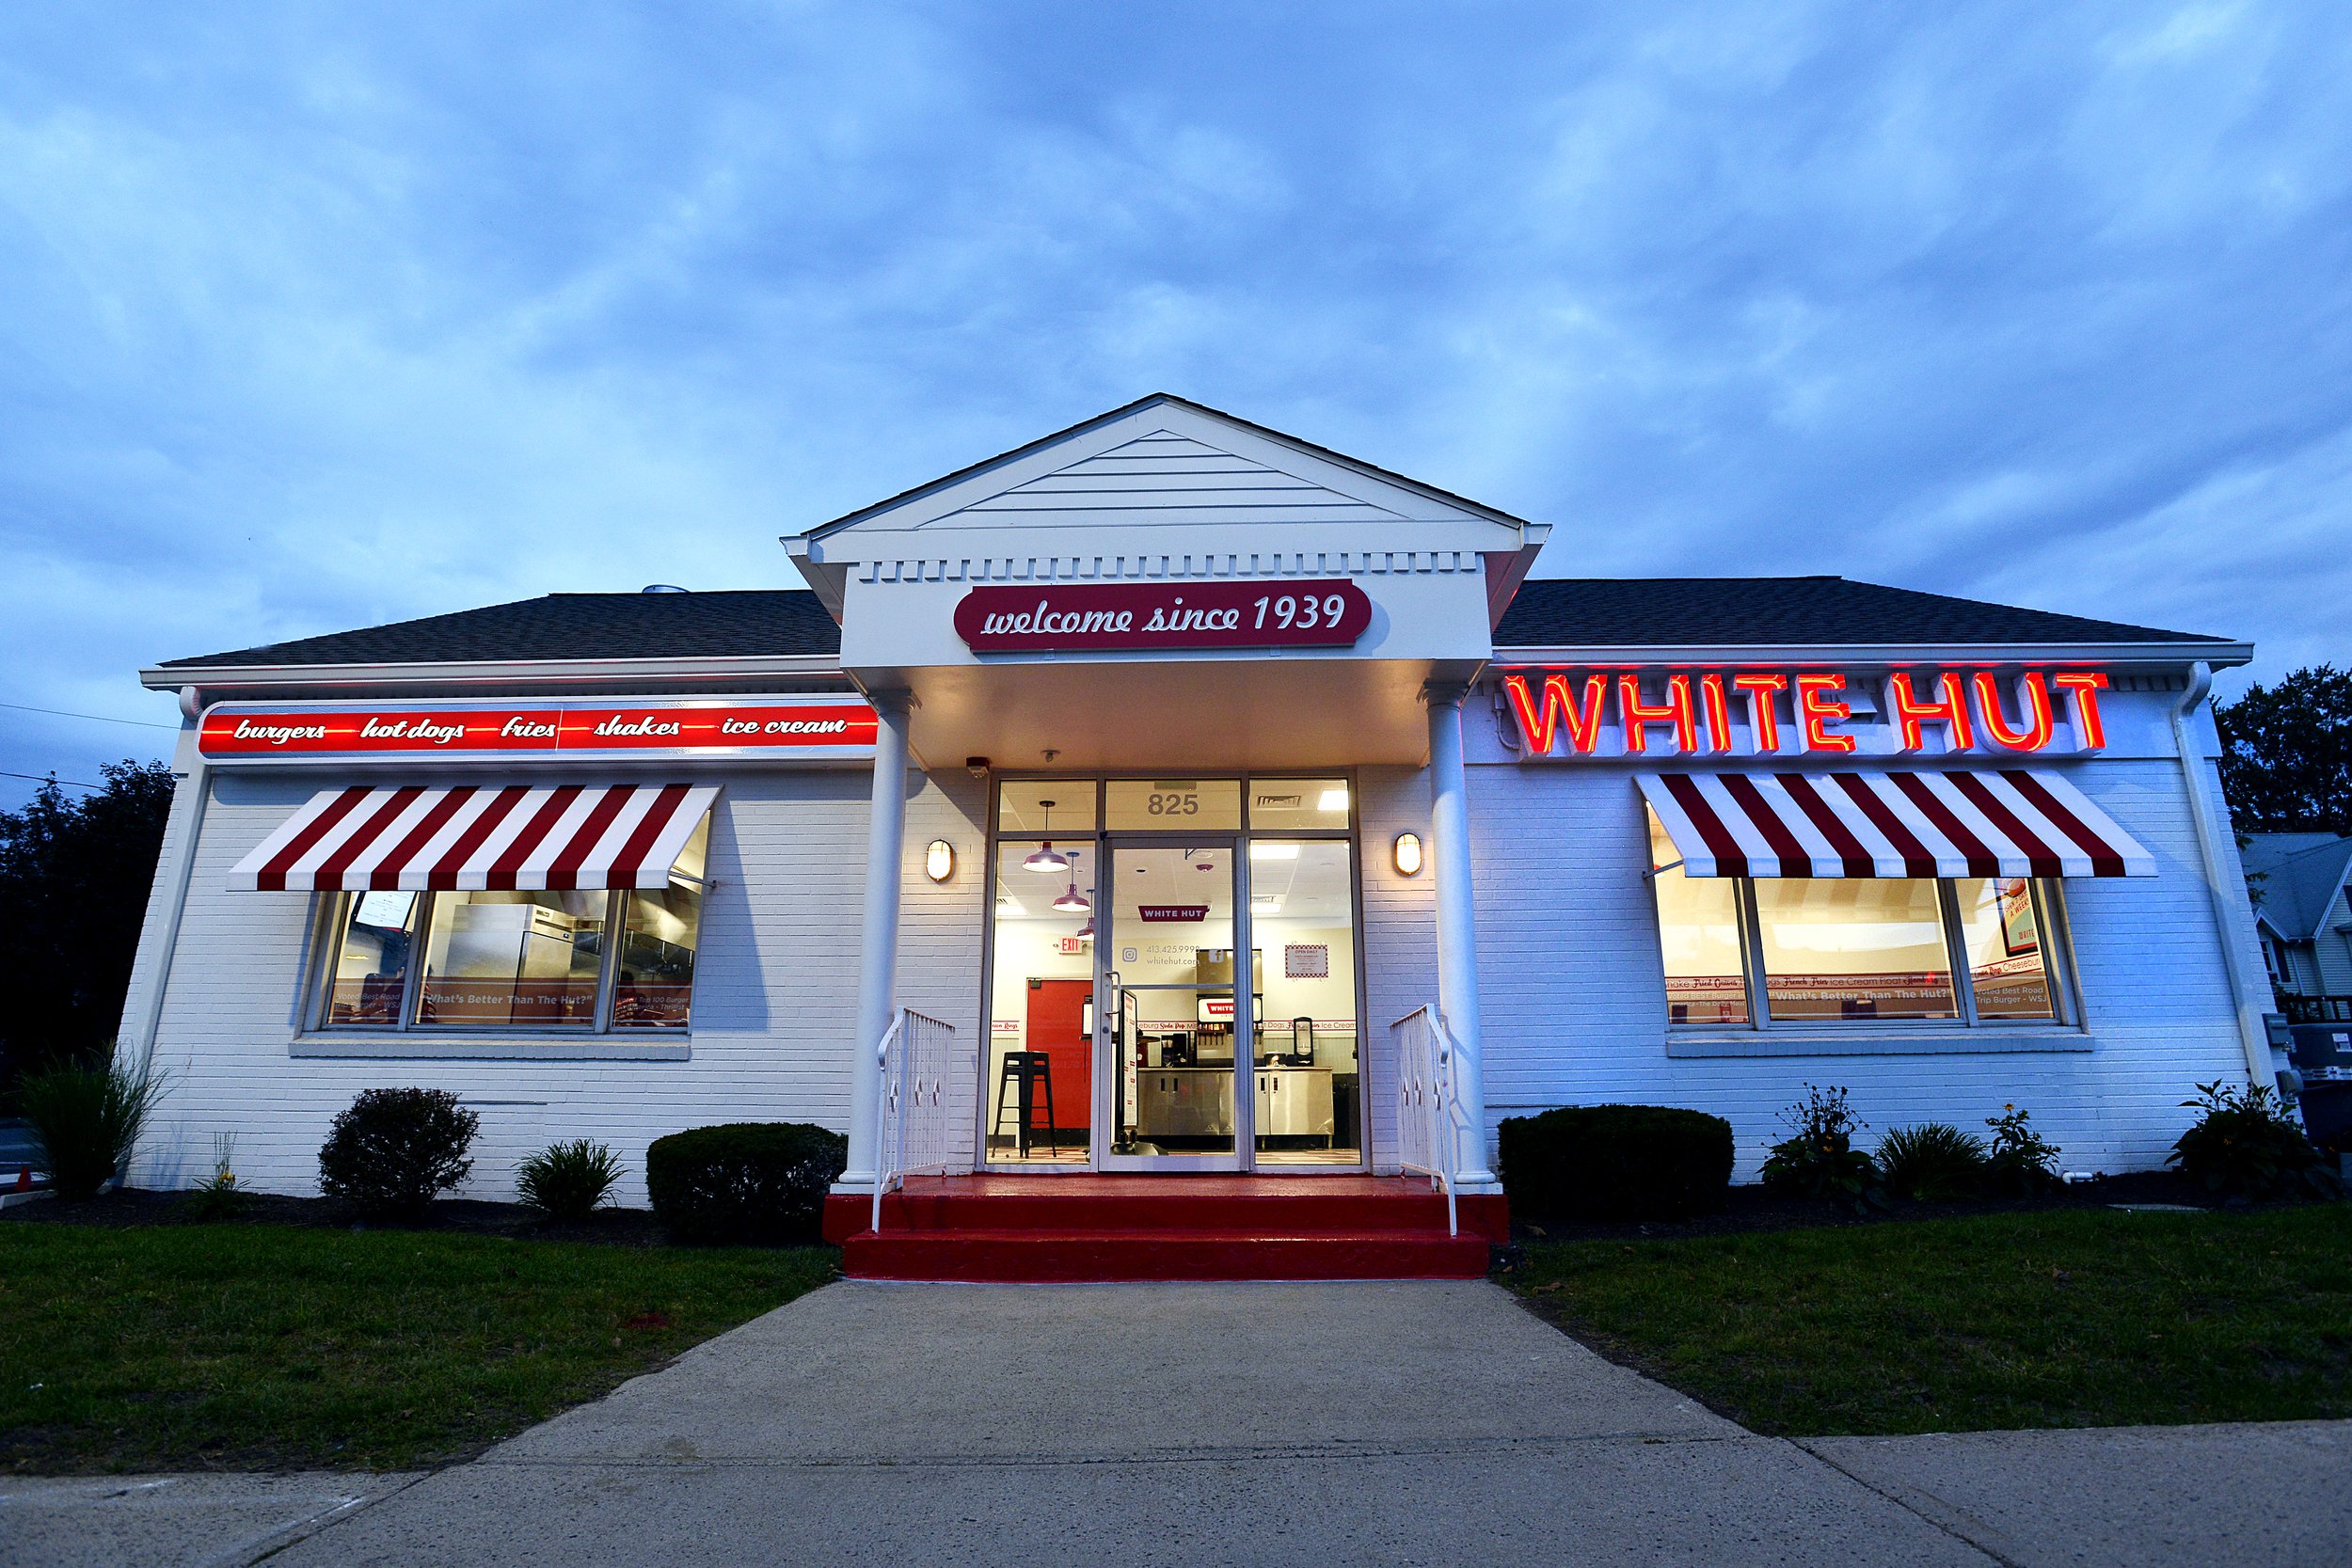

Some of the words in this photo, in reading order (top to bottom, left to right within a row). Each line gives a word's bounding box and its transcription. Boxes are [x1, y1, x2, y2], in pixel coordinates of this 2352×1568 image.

[980, 598, 1133, 635] welcome
[1141, 596, 1240, 632] since
[1253, 594, 1346, 629] 1939
[1504, 673, 1857, 754] WHITE
[1887, 671, 2110, 754] HUT
[232, 719, 326, 745] burgers
[500, 716, 557, 738] fries
[594, 715, 681, 736] shakes
[722, 717, 760, 735] ice
[764, 718, 849, 735] cream
[1148, 794, 1199, 816] 825
[1062, 938, 1079, 951] EXIT
[1146, 958, 1200, 967] whitehut.com
[1666, 979, 1689, 988] hake
[1783, 976, 1807, 987] French
[1846, 977, 1878, 986] Cream
[468, 994, 503, 1004] Better
[507, 995, 533, 1004] Than
[537, 995, 557, 1004] The
[1862, 990, 1894, 1000] Than
[1896, 990, 1916, 999] The
[1976, 996, 1992, 1005] Trip
